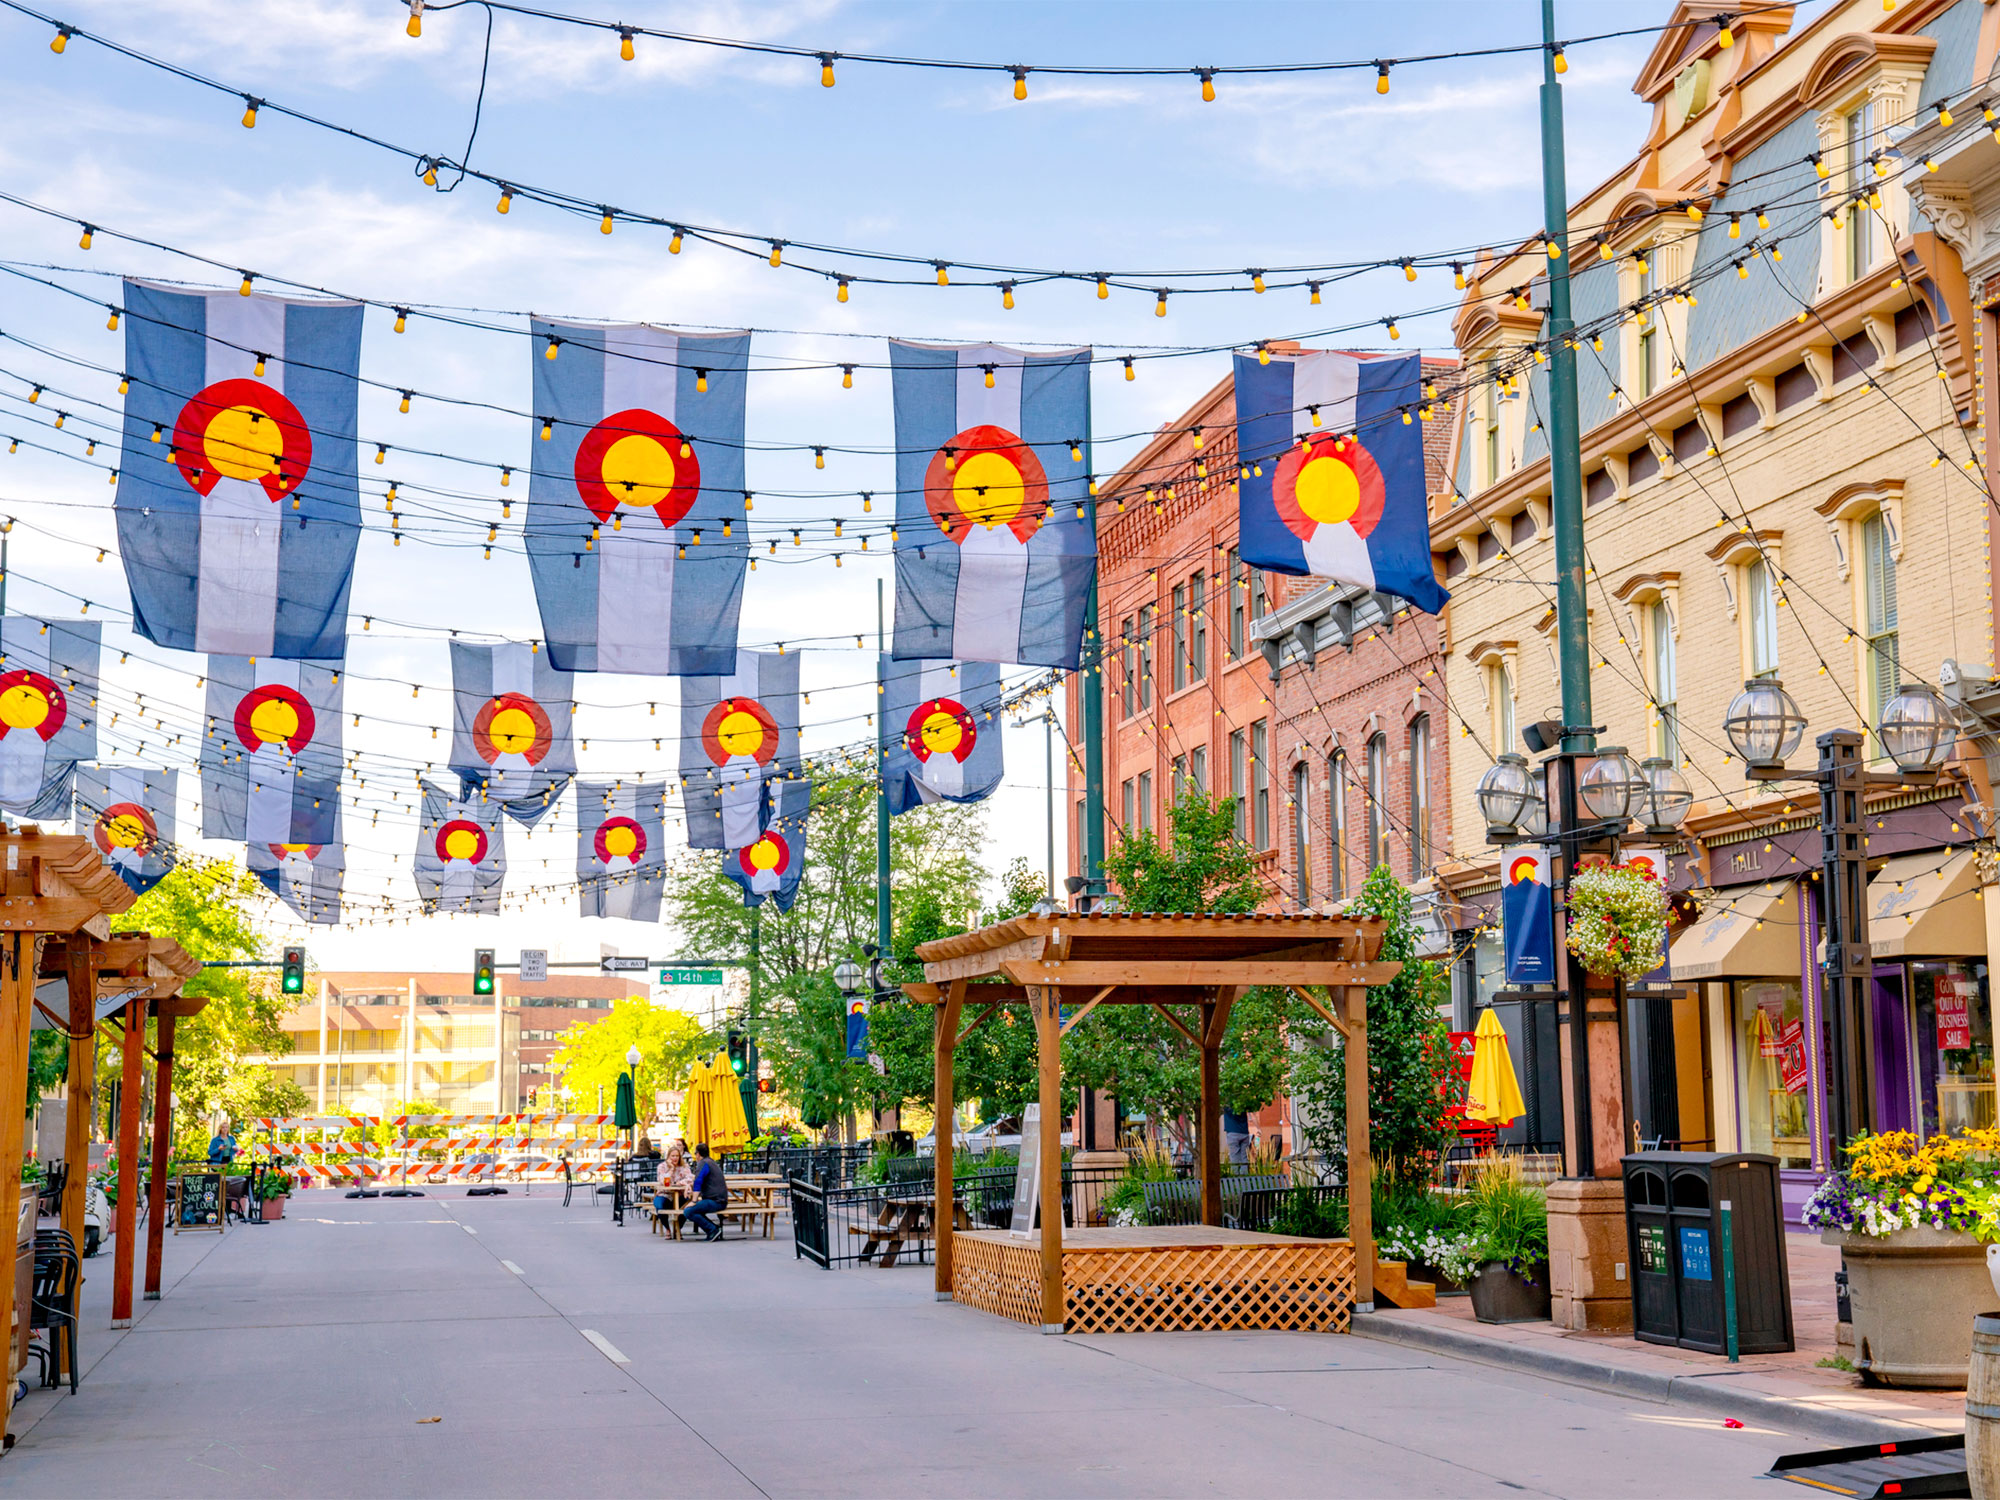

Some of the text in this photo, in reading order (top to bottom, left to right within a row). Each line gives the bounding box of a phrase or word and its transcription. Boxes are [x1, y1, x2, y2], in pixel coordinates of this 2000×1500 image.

[1730, 851, 1762, 874] HALL
[524, 951, 544, 959] BEGIN
[677, 972, 703, 983] 14th
[1939, 996, 1964, 1011] OUT OF
[1938, 1013, 1968, 1029] BUSINESS
[1946, 1031, 1962, 1046] SALE
[183, 1176, 206, 1184] TREAT
[187, 1182, 218, 1192] YOUR PUP
[183, 1193, 202, 1204] SHOP
